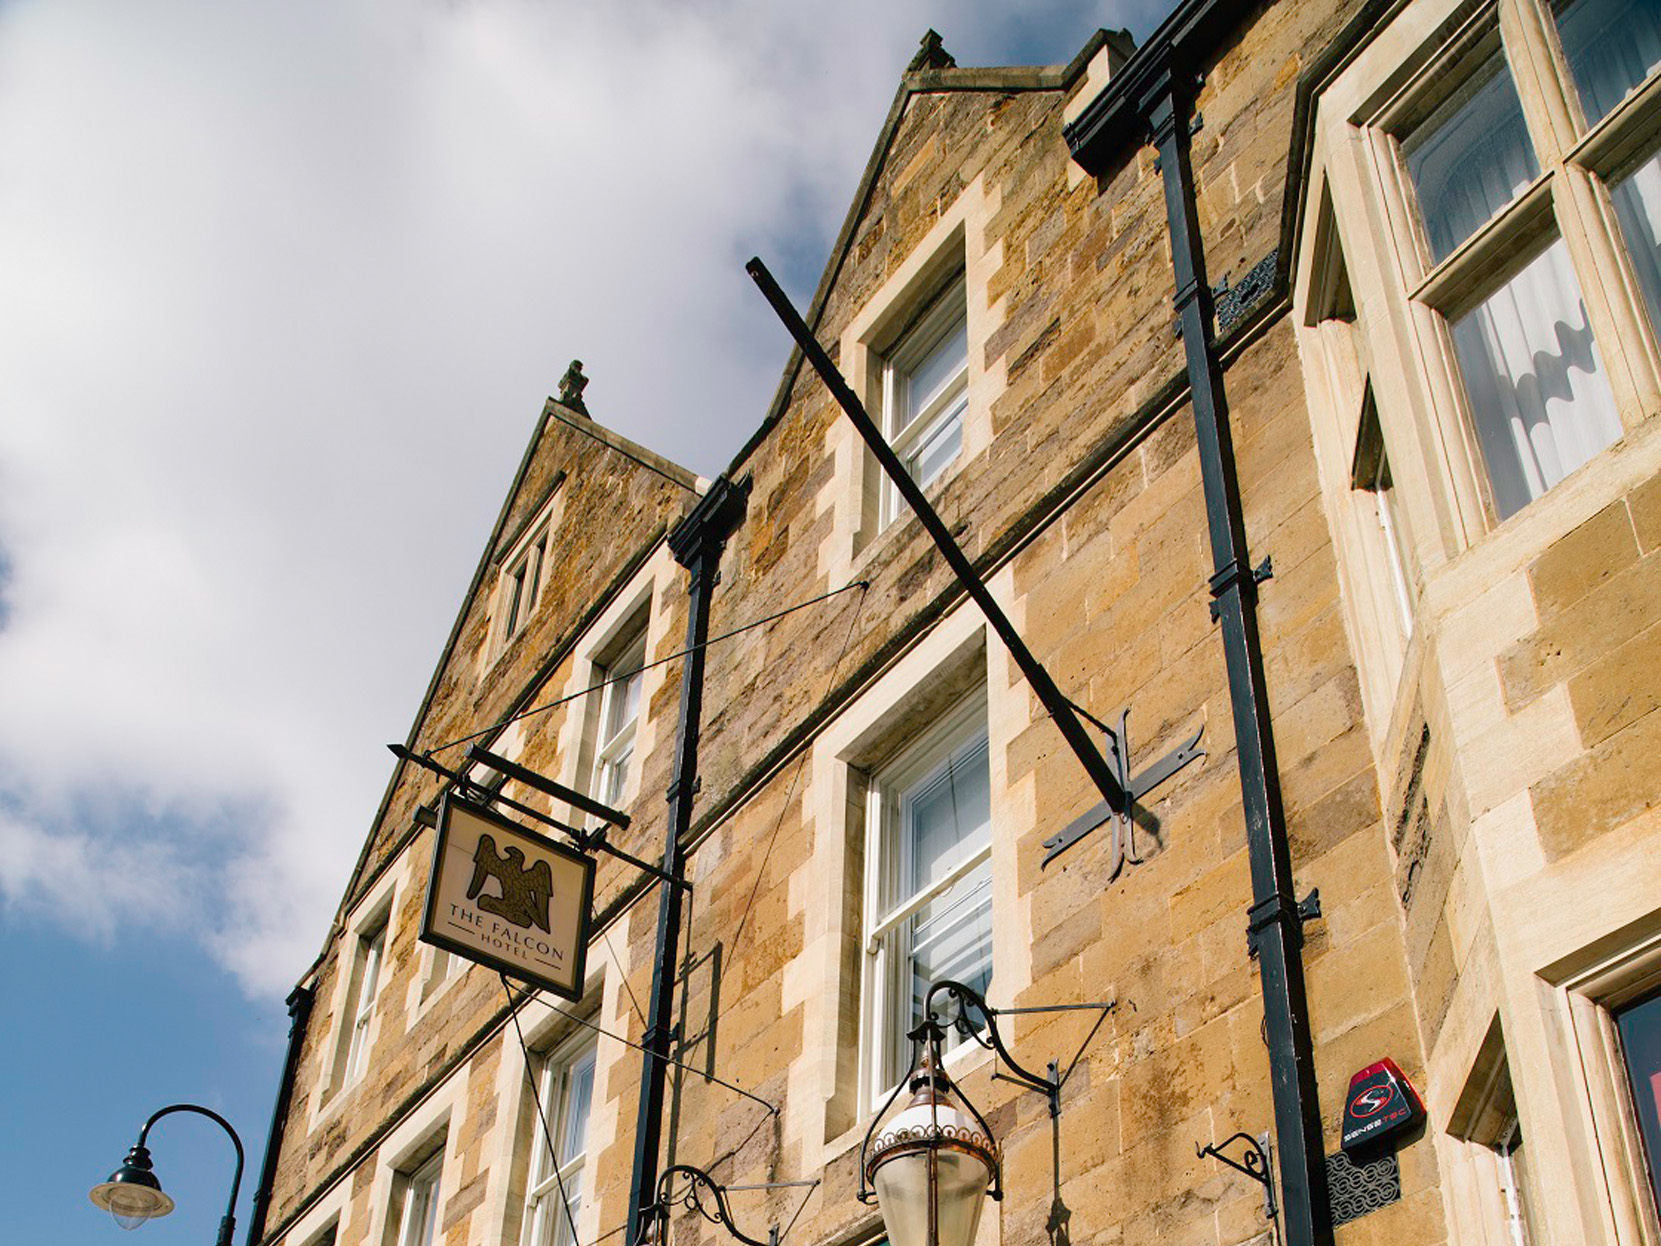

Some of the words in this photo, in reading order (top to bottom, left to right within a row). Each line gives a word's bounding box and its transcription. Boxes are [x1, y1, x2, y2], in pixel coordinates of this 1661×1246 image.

[450, 903, 484, 928] THE
[492, 921, 565, 961] FALCON
[481, 935, 528, 960] HOTEL
